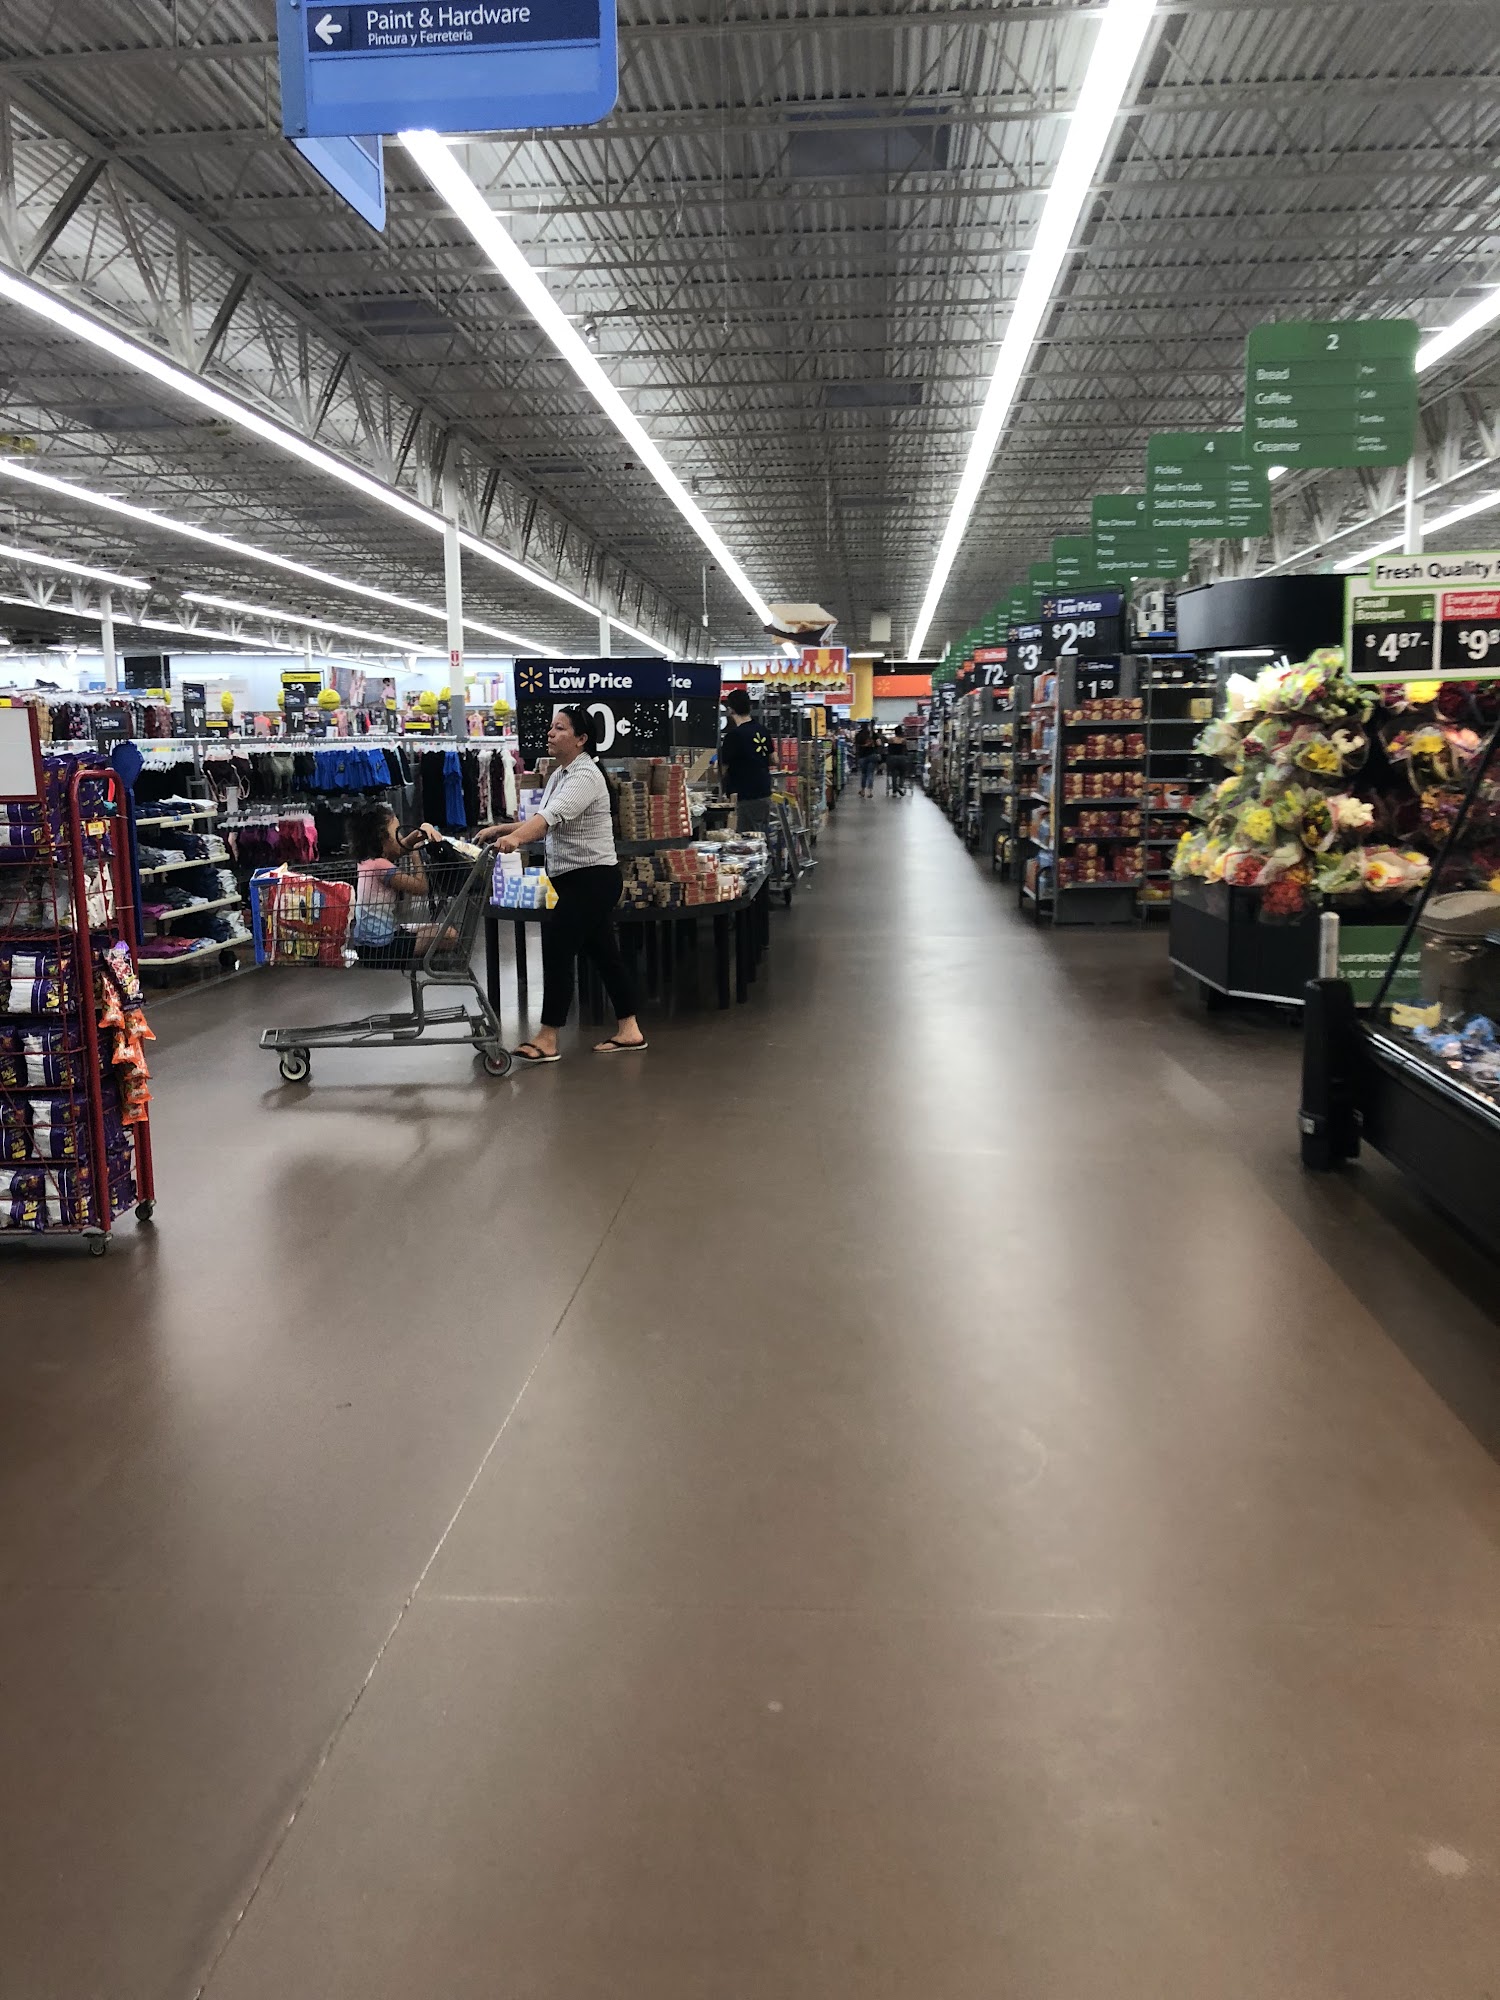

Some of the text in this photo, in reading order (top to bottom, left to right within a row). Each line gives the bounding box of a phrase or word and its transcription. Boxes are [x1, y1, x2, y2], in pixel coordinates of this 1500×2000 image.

[366, 4, 531, 31] Paint & Hardware
[368, 28, 473, 47] Pintura y Ferretería
[1326, 333, 1339, 351] 2
[1255, 368, 1290, 381] Bread
[1254, 391, 1293, 405] Coffee
[1255, 416, 1299, 429] Tortillas
[1204, 441, 1215, 453] 4
[1253, 440, 1301, 453] Creamer
[1154, 465, 1183, 475] Pickles
[1153, 483, 1203, 492] Asian Foods
[1136, 500, 1146, 511] 6
[1154, 499, 1177, 509] Salad
[1178, 499, 1217, 510] Dressings
[1152, 518, 1182, 527] Canned
[1182, 517, 1225, 528] Vegetables
[1376, 562, 1423, 580] Fresh
[1427, 560, 1493, 579] Quality
[1354, 596, 1389, 609] Small
[1444, 592, 1500, 606] Everyday
[1354, 608, 1406, 622] Bouquet
[1444, 605, 1499, 618] Bouquet
[549, 666, 581, 675] Everyday
[549, 672, 633, 689] Low Price
[667, 674, 692, 689] ice
[1339, 951, 1396, 963] uaranteed
